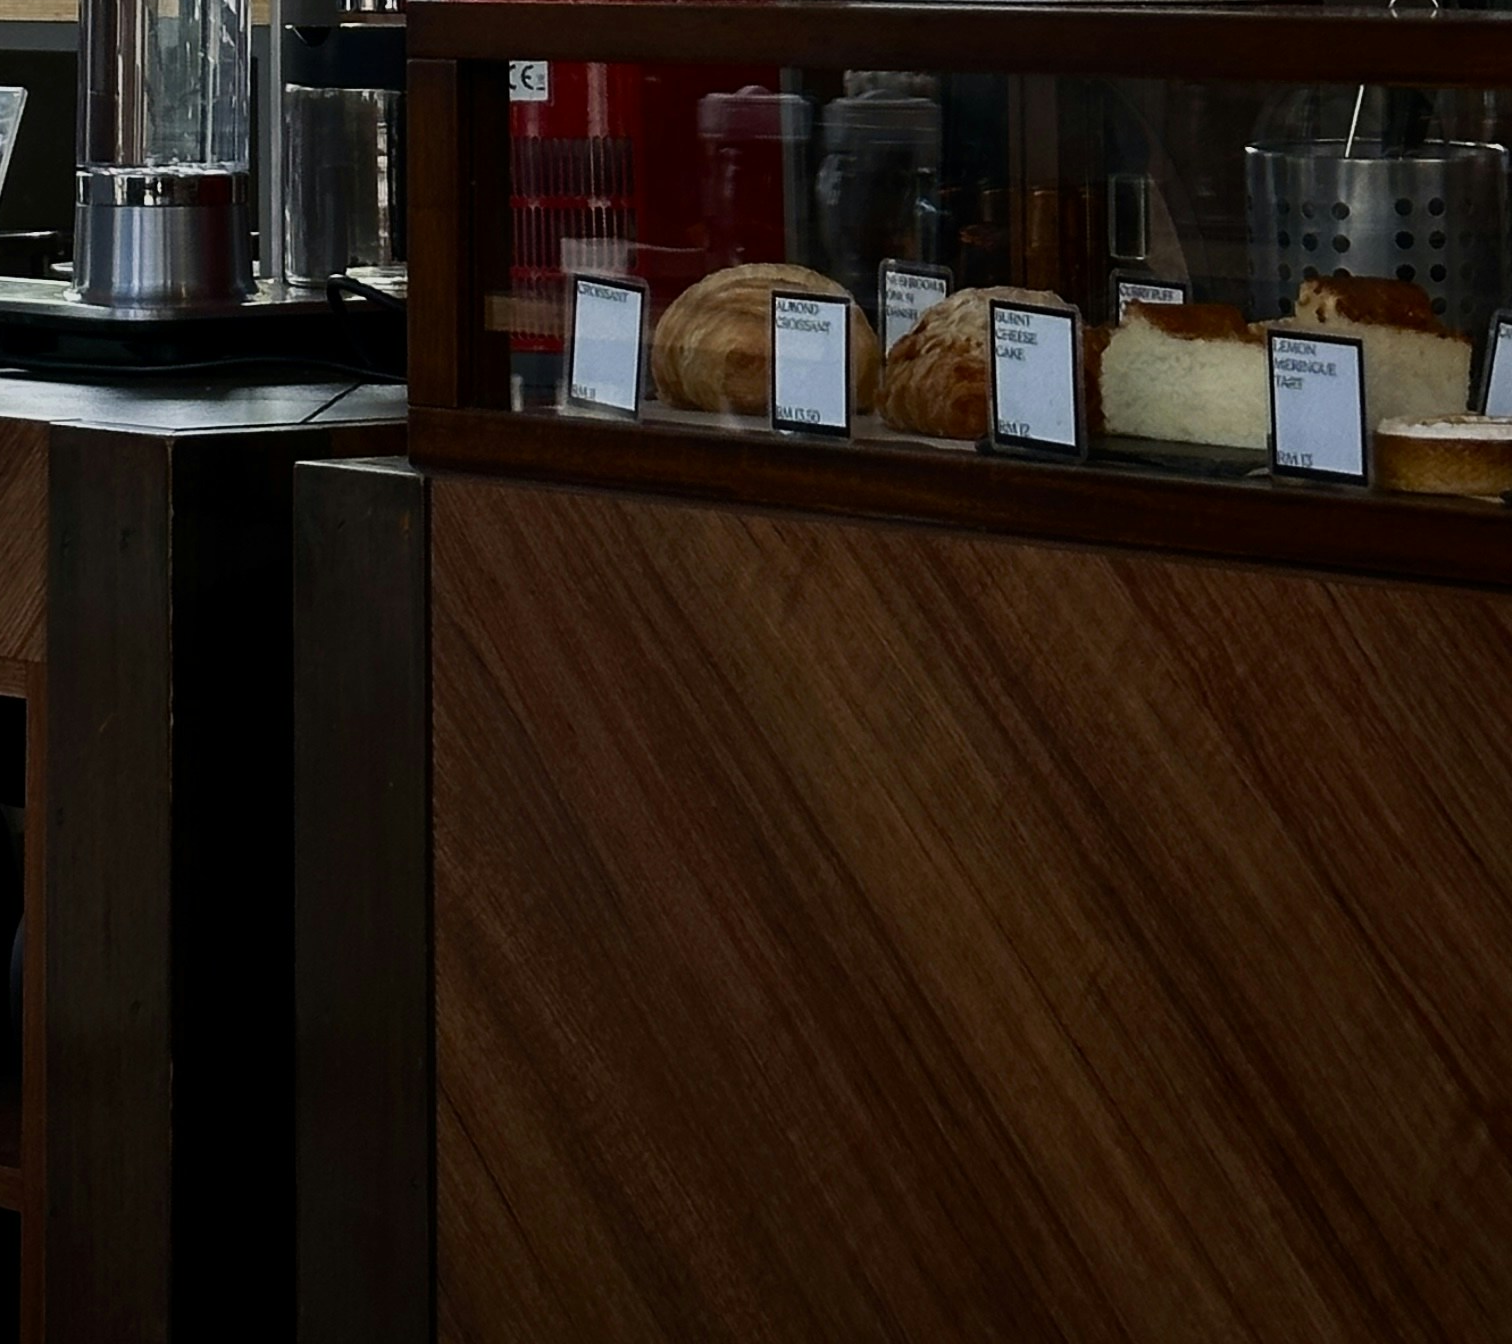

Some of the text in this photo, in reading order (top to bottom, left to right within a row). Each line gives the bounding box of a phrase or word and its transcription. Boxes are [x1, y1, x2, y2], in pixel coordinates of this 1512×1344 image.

[776, 300, 819, 316] ALMOND
[776, 316, 831, 334] CROISSANT
[995, 310, 1031, 327] BURNT
[996, 328, 1038, 345] CHEESE
[996, 345, 1026, 362] CAKE
[1273, 339, 1317, 356] LEMON
[1275, 357, 1337, 376] MERINGUE
[1277, 375, 1303, 391] TART
[776, 405, 793, 420] RM
[998, 419, 1017, 434] RM
[1277, 450, 1299, 466] RM
